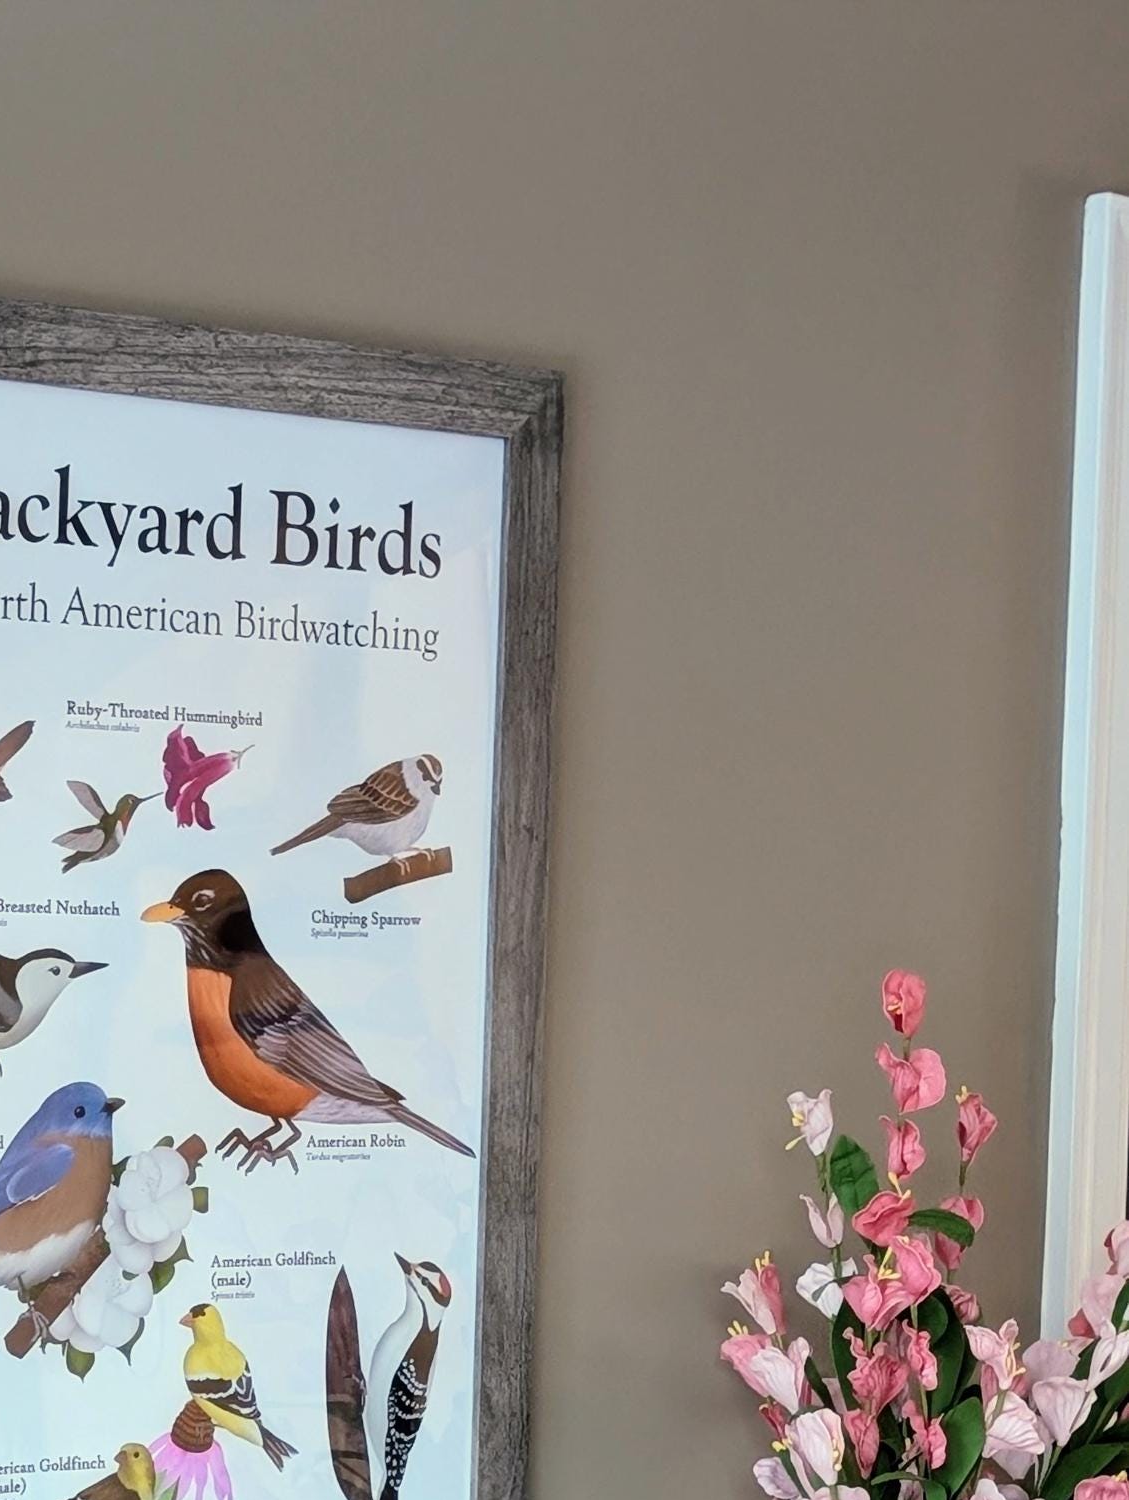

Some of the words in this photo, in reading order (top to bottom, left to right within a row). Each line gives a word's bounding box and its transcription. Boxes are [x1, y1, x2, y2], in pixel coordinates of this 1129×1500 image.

[267, 488, 442, 580] Birds
[59, 585, 224, 637] American
[233, 599, 440, 662] Birdwatching
[66, 700, 169, 720] Ruby-Throated
[172, 706, 262, 727] Hummingbird
[55, 899, 120, 916] Nuthatch
[311, 909, 369, 931] Chipping
[369, 910, 421, 930] Sparrow
[307, 1133, 366, 1148] American
[369, 1133, 406, 1148] Robin
[210, 1254, 273, 1268] American
[275, 1251, 336, 1266] Goldfinch
[211, 1274, 253, 1290] (male)
[39, 1455, 106, 1472] Goldfinch
